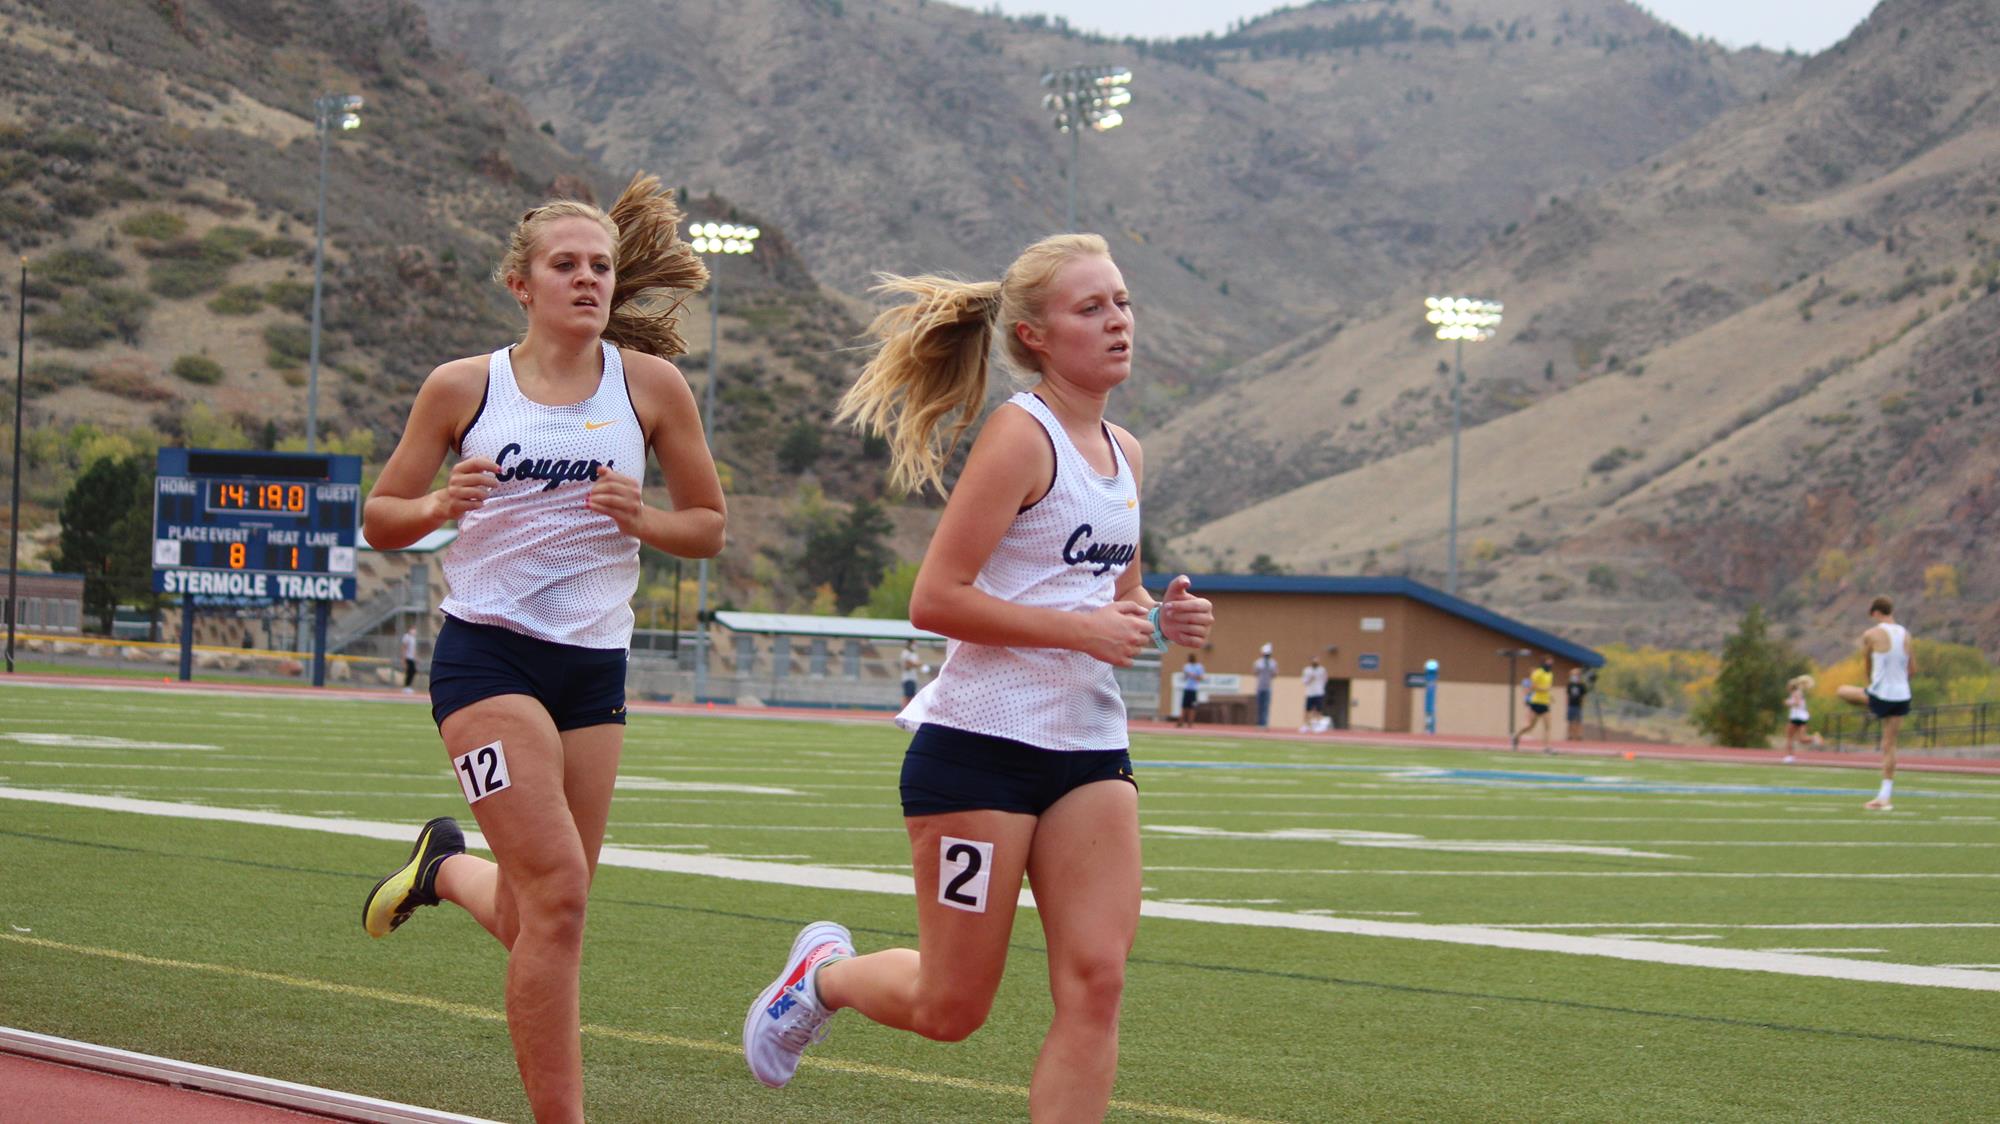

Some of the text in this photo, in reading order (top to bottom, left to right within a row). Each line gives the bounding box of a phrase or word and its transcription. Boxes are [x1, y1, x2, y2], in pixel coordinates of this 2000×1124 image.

[495, 443, 614, 492] Cougar
[160, 480, 197, 496] HOME
[316, 486, 356, 502] GUEST
[168, 525, 249, 543] PLACE EVENT
[267, 530, 339, 547] HEAT LANE
[229, 543, 246, 569] 8
[291, 547, 298, 570] 1
[164, 570, 344, 600] STERMOLE TRACK
[460, 747, 504, 798] 12
[944, 843, 983, 907] 2
